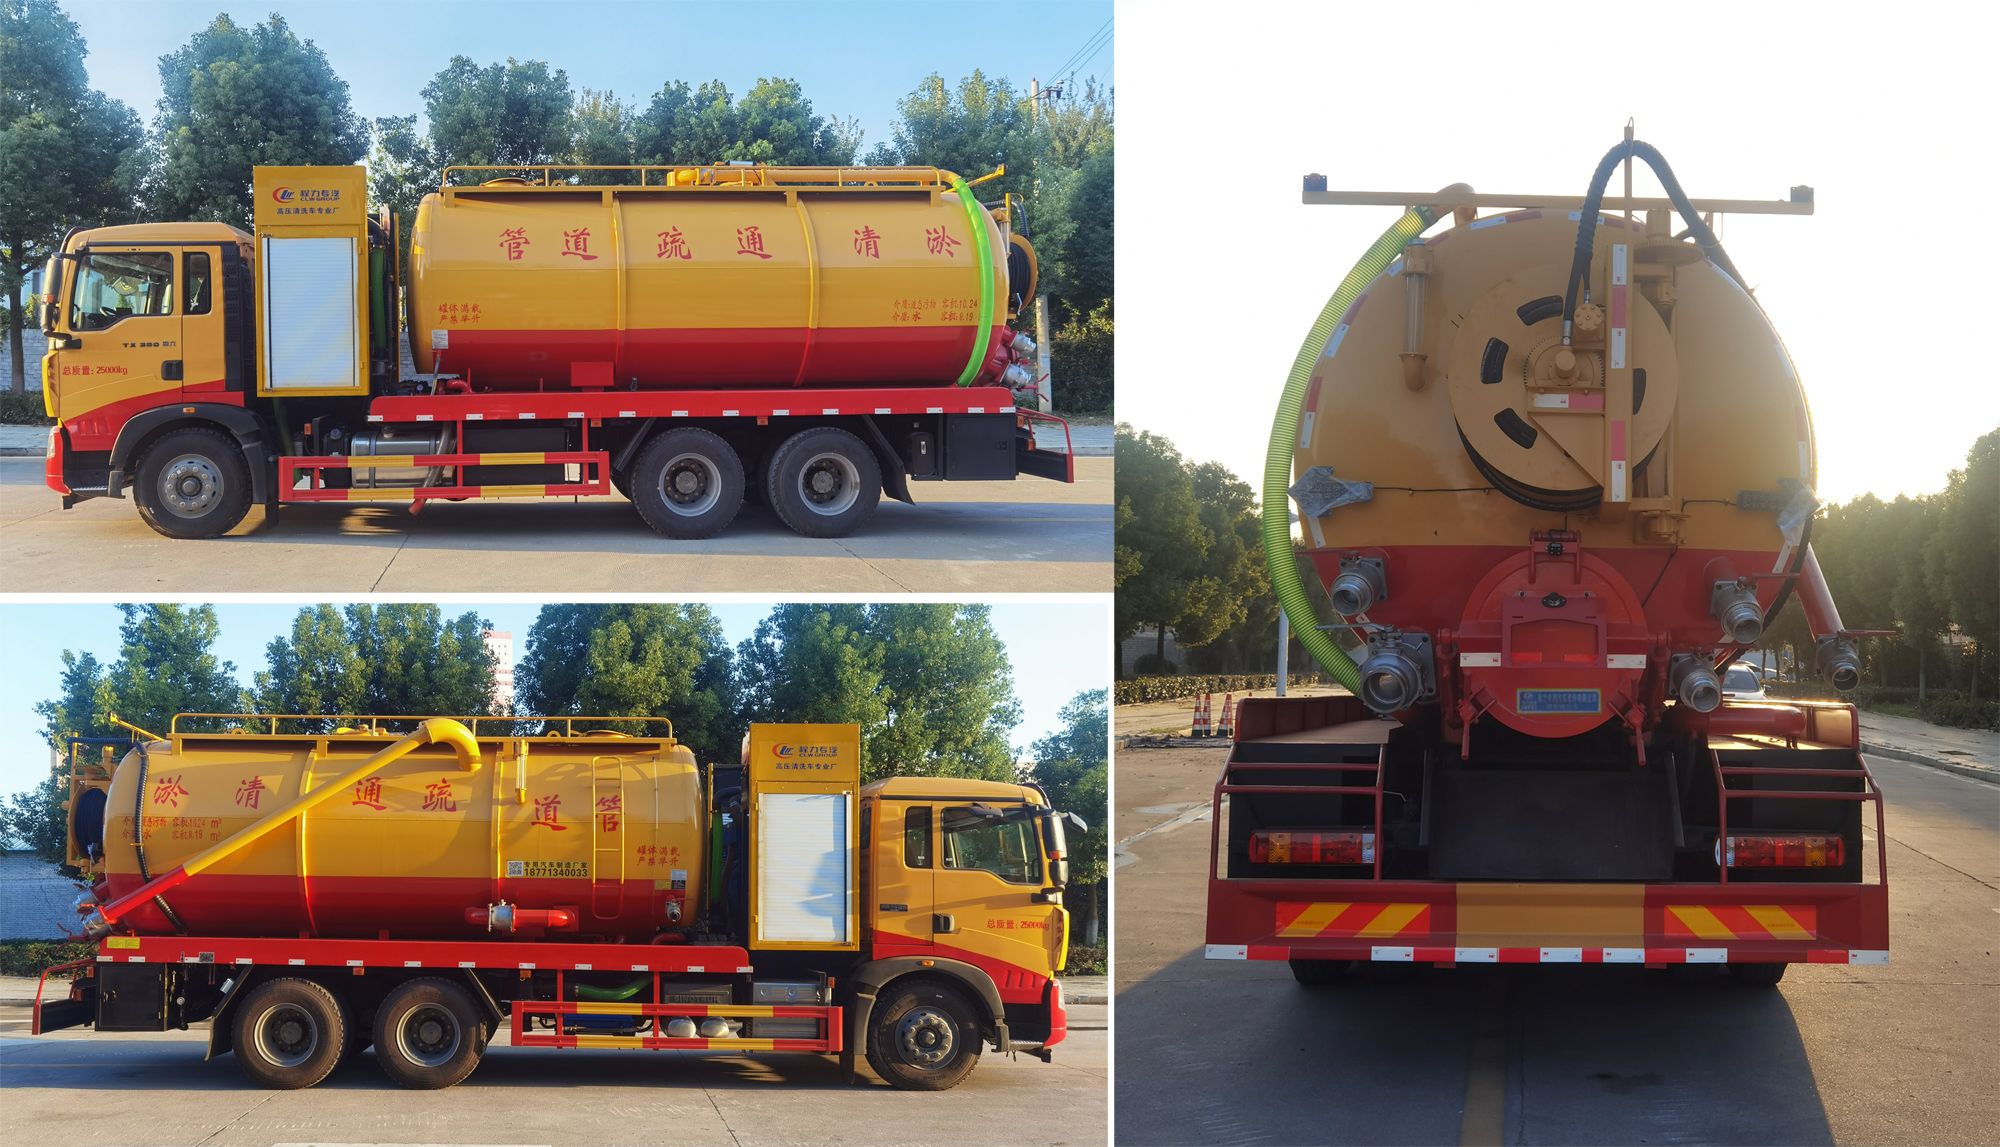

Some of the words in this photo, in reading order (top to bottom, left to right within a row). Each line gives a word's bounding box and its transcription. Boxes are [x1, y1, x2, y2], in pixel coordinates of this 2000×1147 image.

[276, 207, 340, 215] 高压清洗车专业厂
[524, 861, 588, 869] 专用汽车制造厂家
[524, 868, 588, 877] 18771340033
